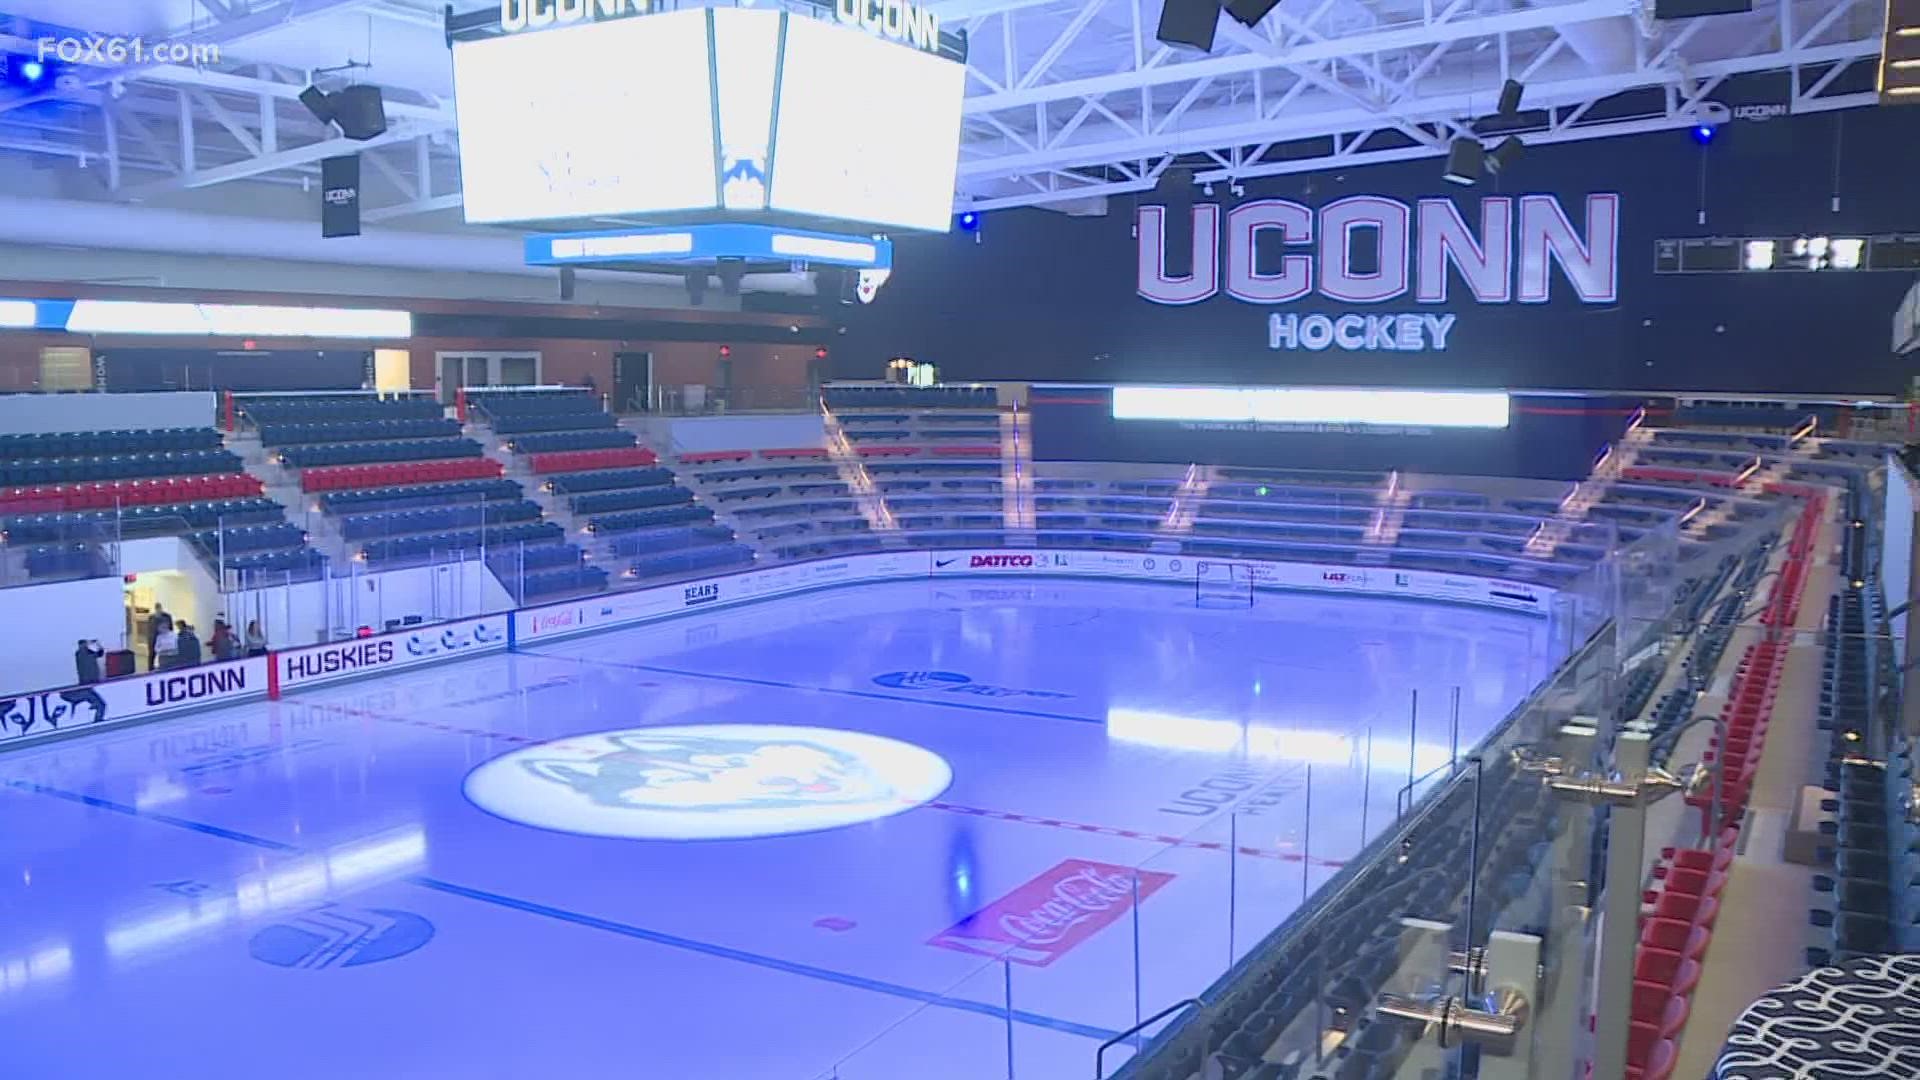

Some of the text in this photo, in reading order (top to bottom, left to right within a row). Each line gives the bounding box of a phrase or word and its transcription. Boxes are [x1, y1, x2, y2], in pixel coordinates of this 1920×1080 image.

[836, 0, 939, 51] UCONN
[1136, 193, 1619, 304] UCONN
[1268, 314, 1456, 350] HOCKEY
[970, 555, 1033, 568] DATTCO
[145, 640, 393, 706] UCONN HUSKIES
